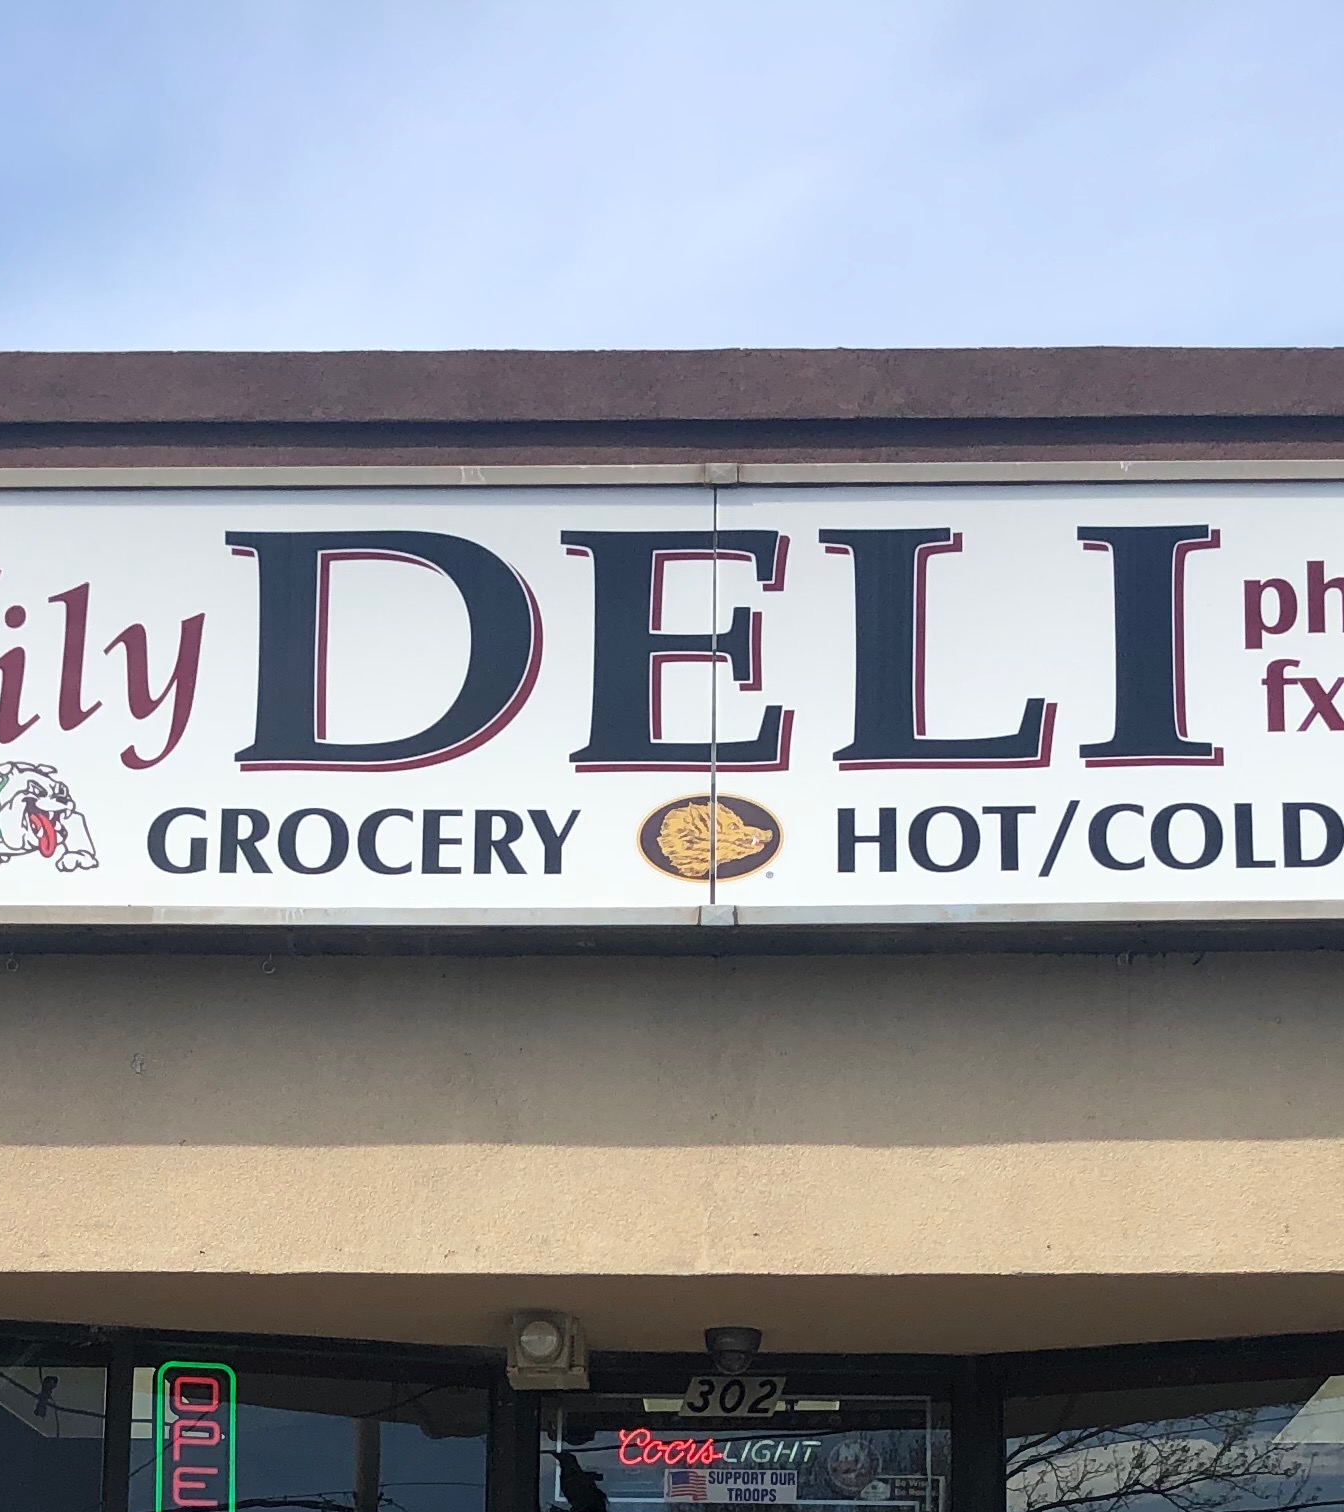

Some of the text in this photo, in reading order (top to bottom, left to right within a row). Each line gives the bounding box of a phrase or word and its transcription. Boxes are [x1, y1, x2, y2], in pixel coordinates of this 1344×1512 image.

[225, 524, 1228, 774] DELI
[147, 807, 582, 877] GROCERY
[686, 1378, 779, 1415] 302
[618, 1427, 822, 1466] Coors LIGHT
[708, 1471, 796, 1486] SUPPORT OUR
[727, 1487, 777, 1502] TROOPS
